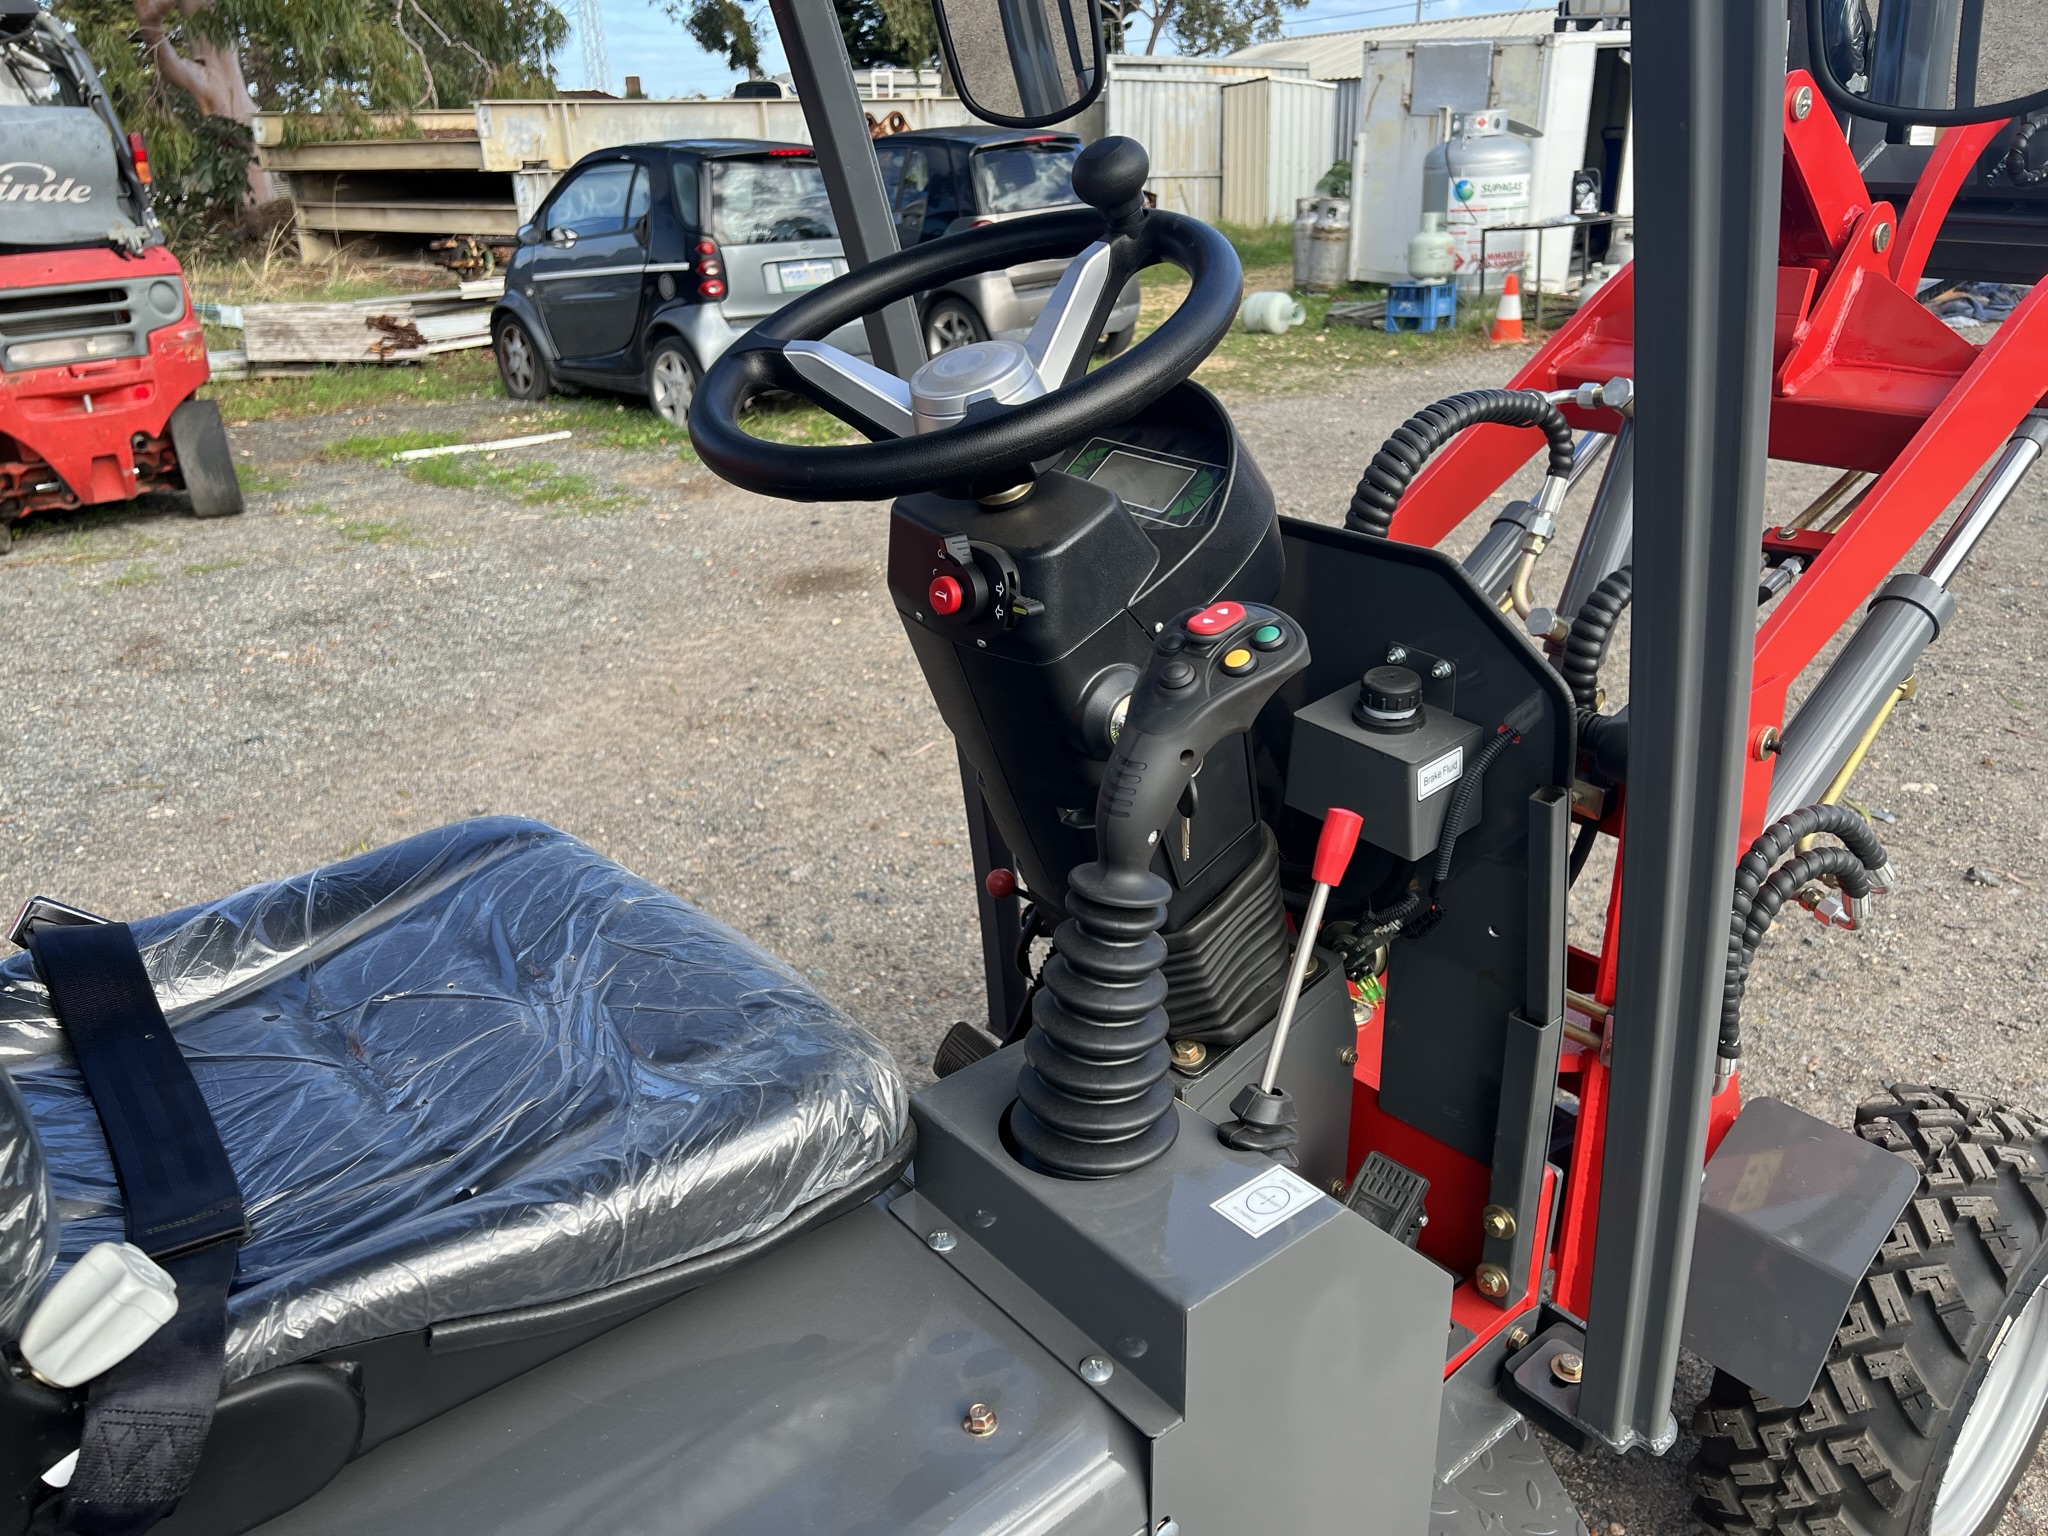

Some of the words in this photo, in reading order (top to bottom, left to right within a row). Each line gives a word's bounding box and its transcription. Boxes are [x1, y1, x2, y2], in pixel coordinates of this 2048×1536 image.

[1481, 182, 1523, 193] SUPAGAS
[1423, 770, 1441, 786] Brake
[1443, 760, 1458, 775] Fluid
